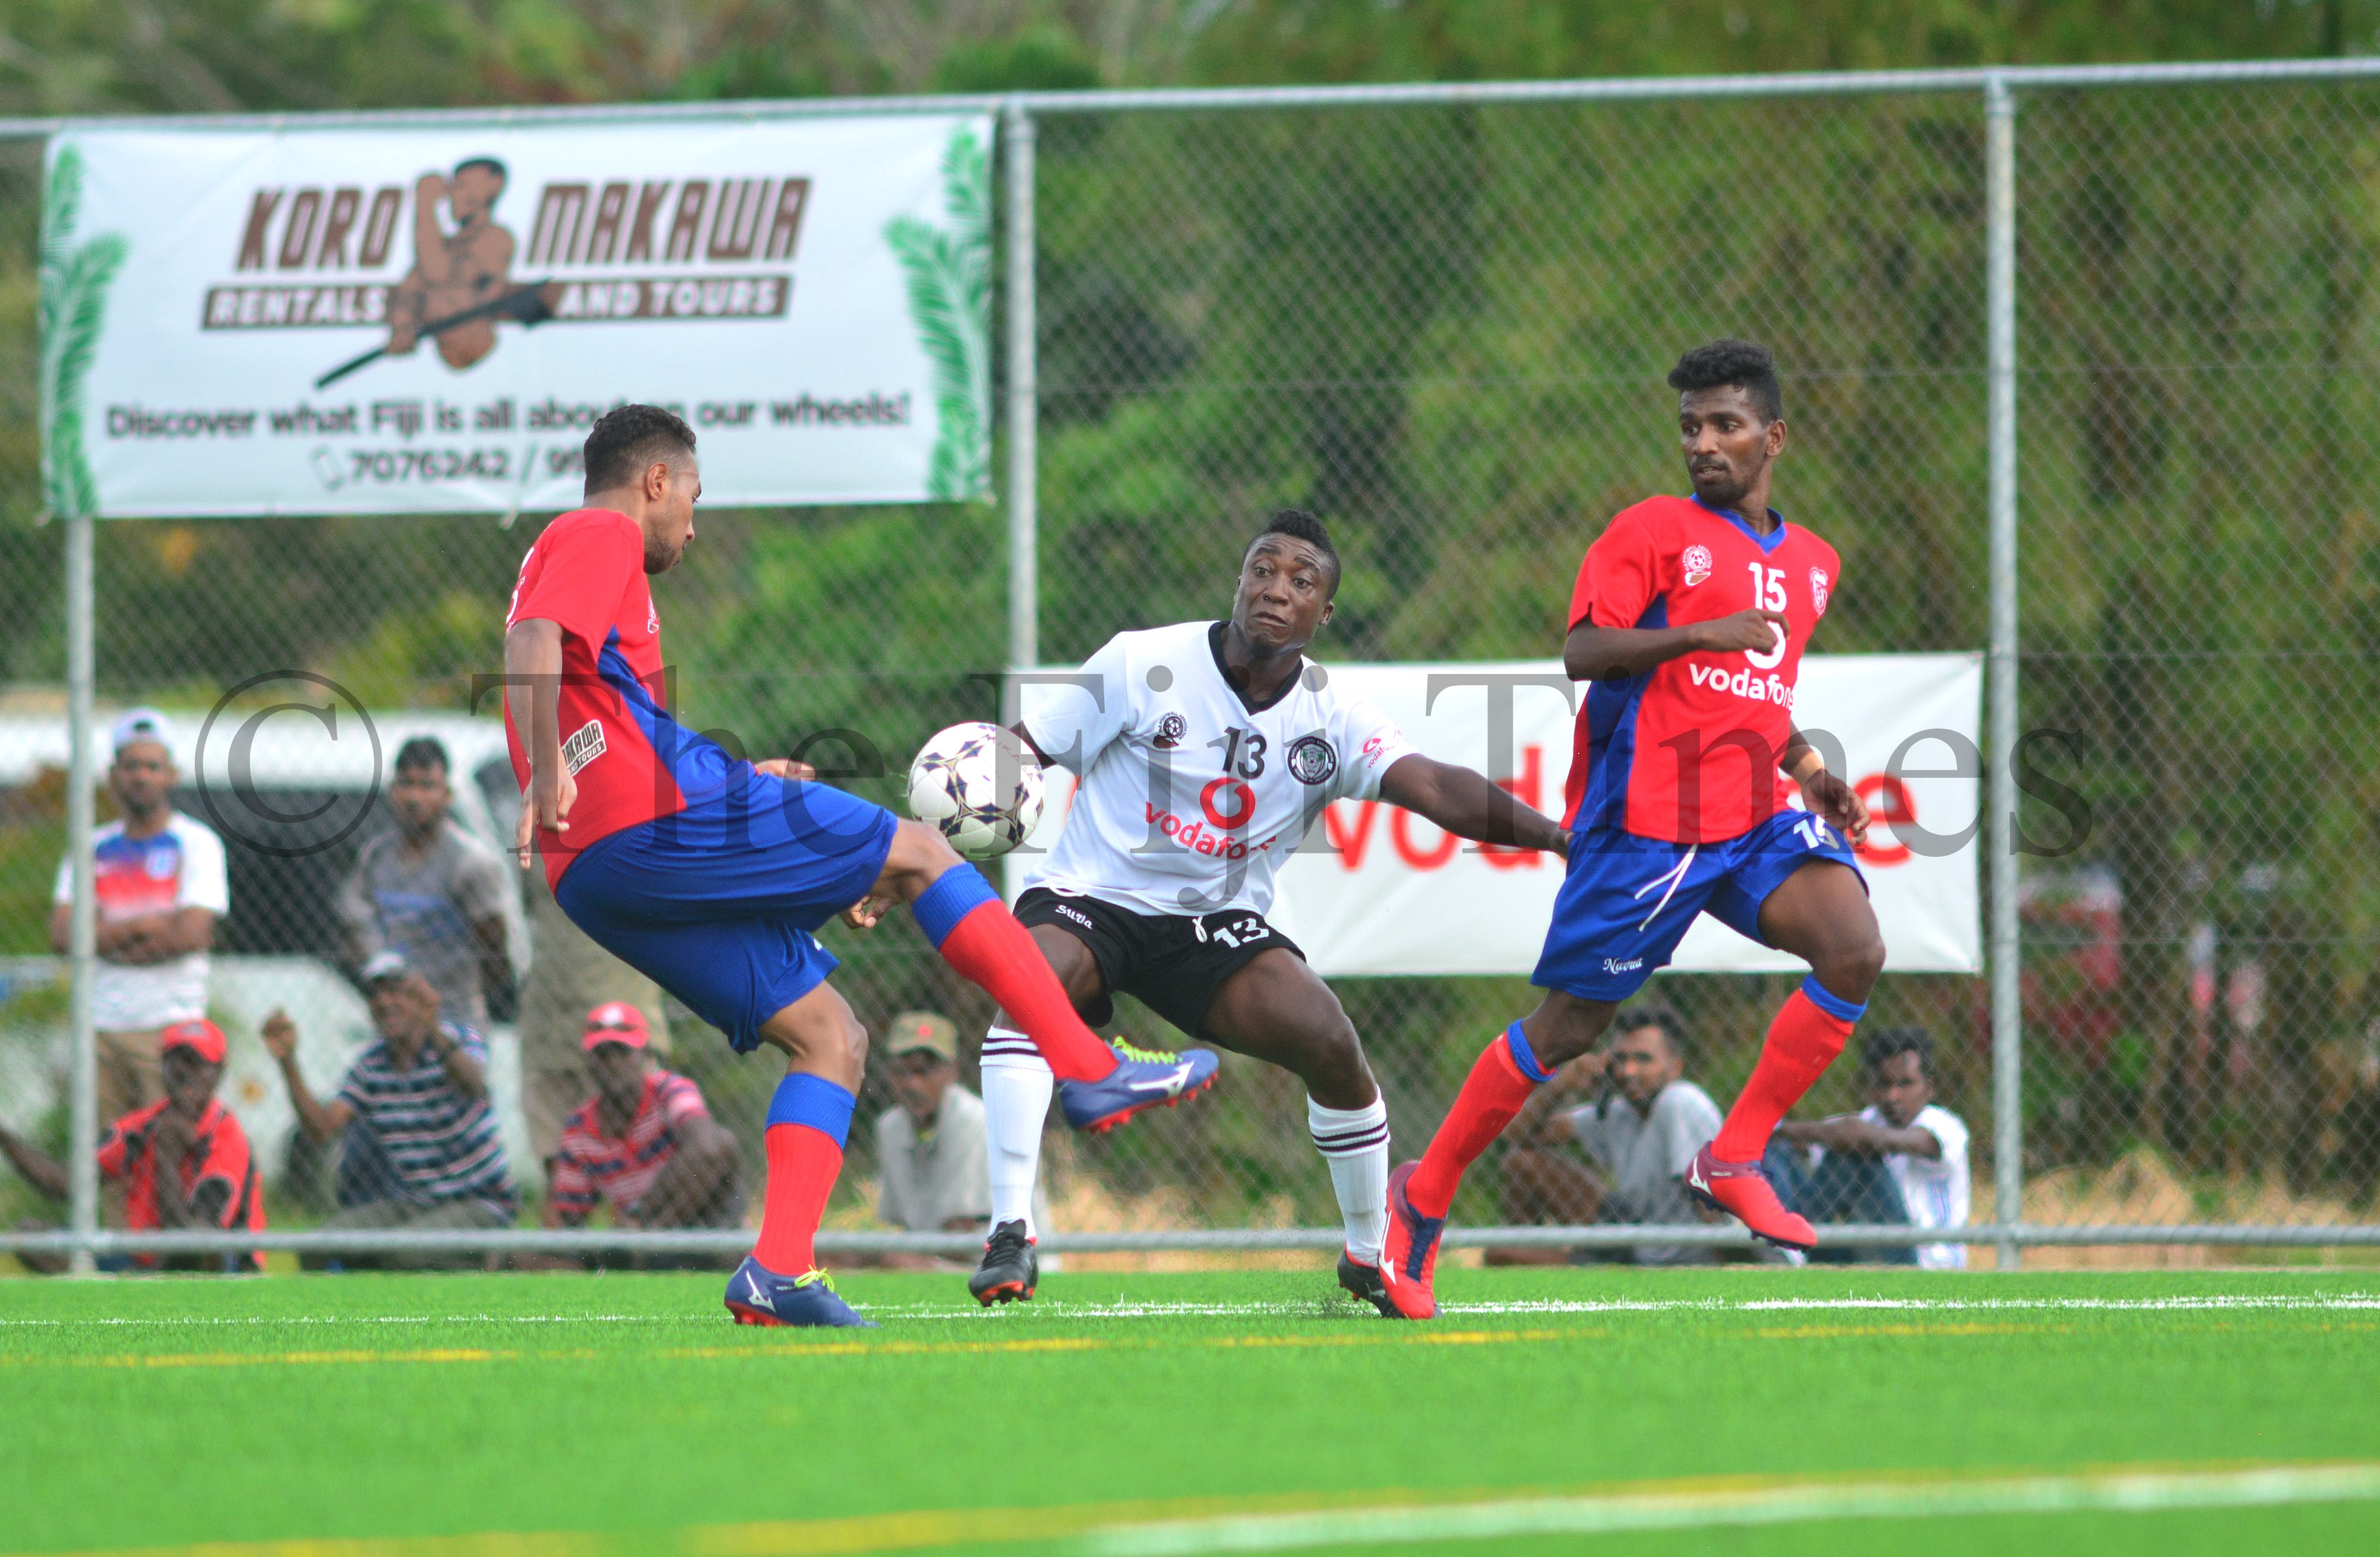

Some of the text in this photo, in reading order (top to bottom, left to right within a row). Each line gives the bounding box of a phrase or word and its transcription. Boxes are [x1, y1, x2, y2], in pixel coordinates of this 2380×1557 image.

[236, 178, 810, 270] KORO MAKAWA
[210, 278, 778, 325] RENTALS AND TOURS
[107, 403, 254, 438] Discover
[268, 398, 358, 435] what
[369, 397, 424, 440] Fiji
[434, 395, 462, 433] is
[474, 395, 516, 432] all
[527, 395, 627, 431] abo
[696, 400, 755, 429] our
[770, 390, 911, 427] wheels!
[349, 446, 512, 482] 7076242
[1749, 562, 1787, 612] 15
[579, 742, 602, 764] TOURS
[1222, 726, 1267, 780] 13
[1793, 814, 1839, 849] 15
[1055, 904, 1092, 929] Suva
[1213, 917, 1269, 948] 13
